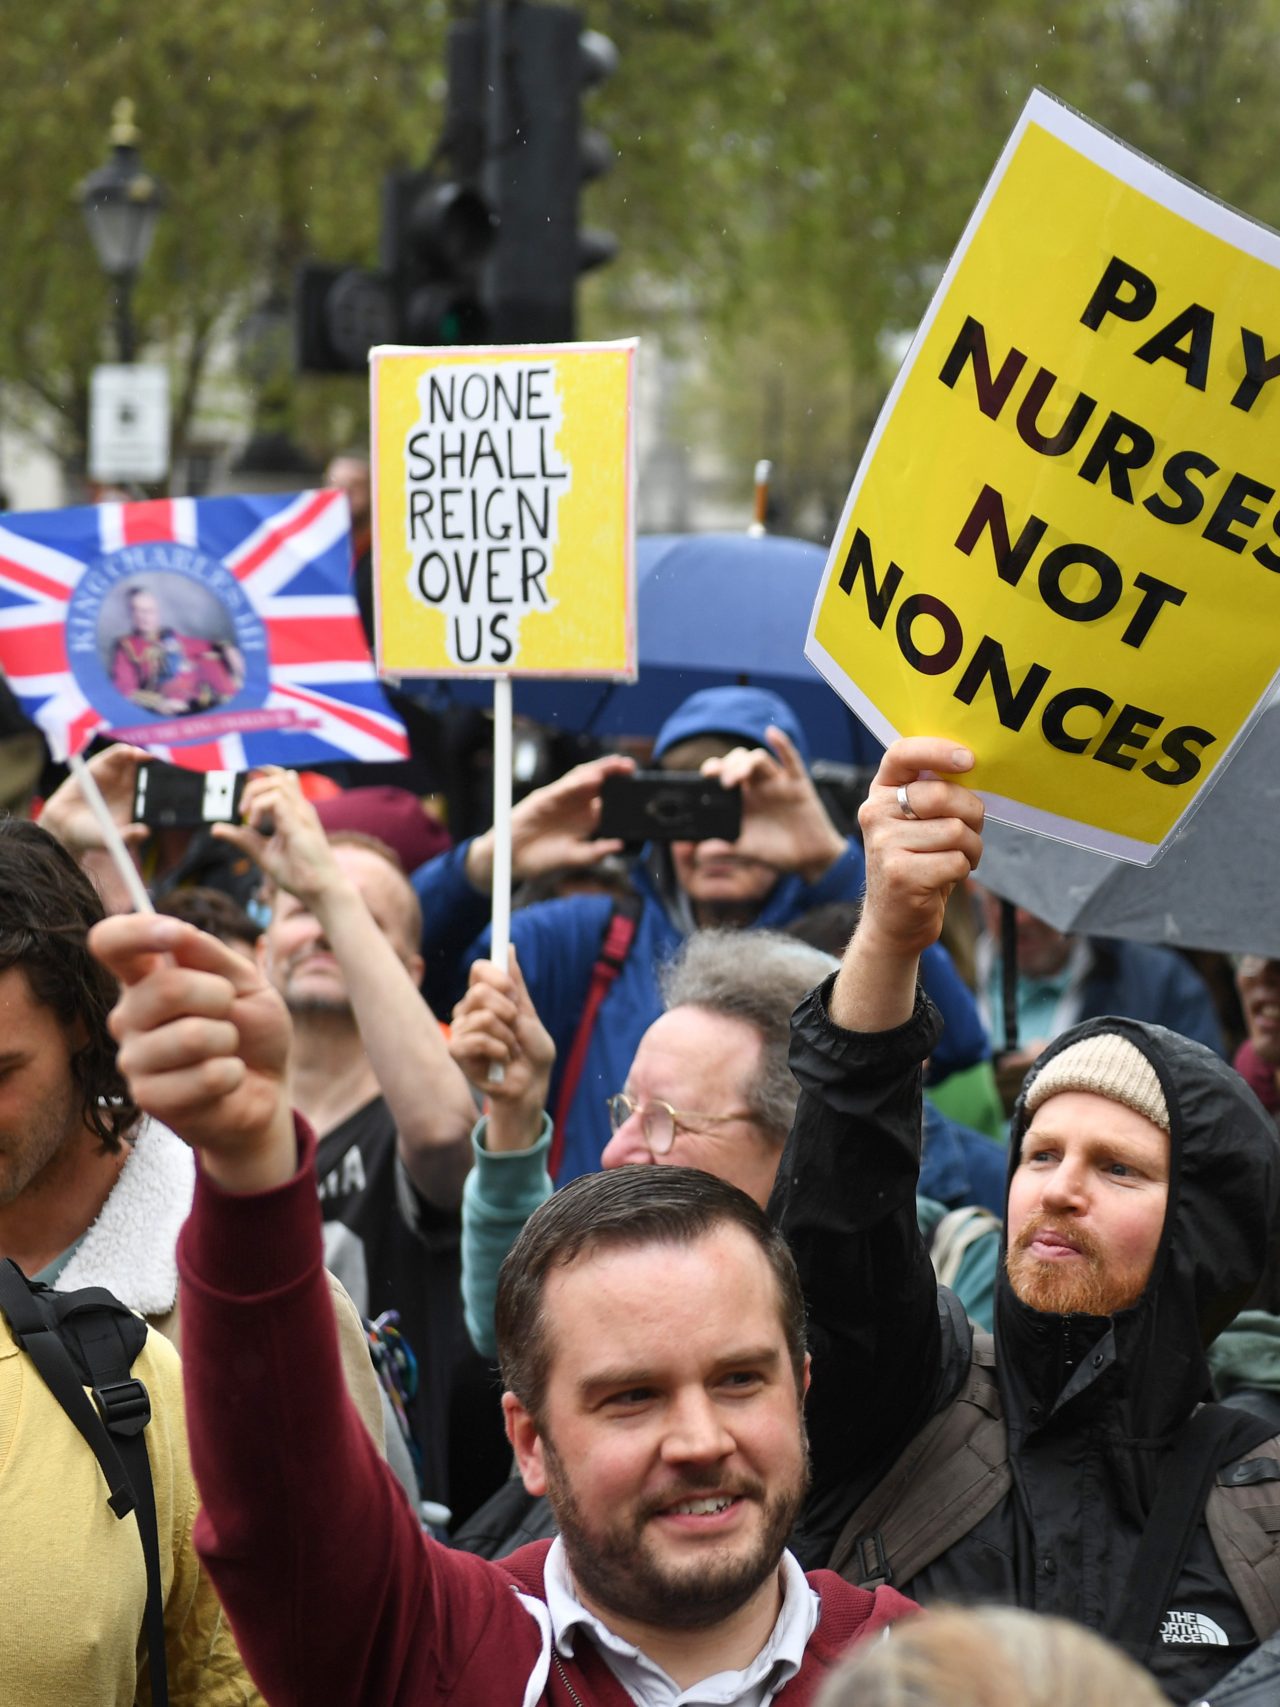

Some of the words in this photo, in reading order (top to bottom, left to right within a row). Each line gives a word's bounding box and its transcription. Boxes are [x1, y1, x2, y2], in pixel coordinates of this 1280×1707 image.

[429, 369, 552, 423] NONE
[408, 428, 568, 481] SHALL
[410, 486, 550, 541] REIGN
[418, 547, 548, 604] OVER
[954, 484, 1188, 649] NOT
[455, 613, 513, 663] US
[838, 527, 1217, 788] NONCES
[1159, 1621, 1199, 1635] ORTH
[1162, 1633, 1202, 1643] FACE
[1167, 1611, 1197, 1624] THE
